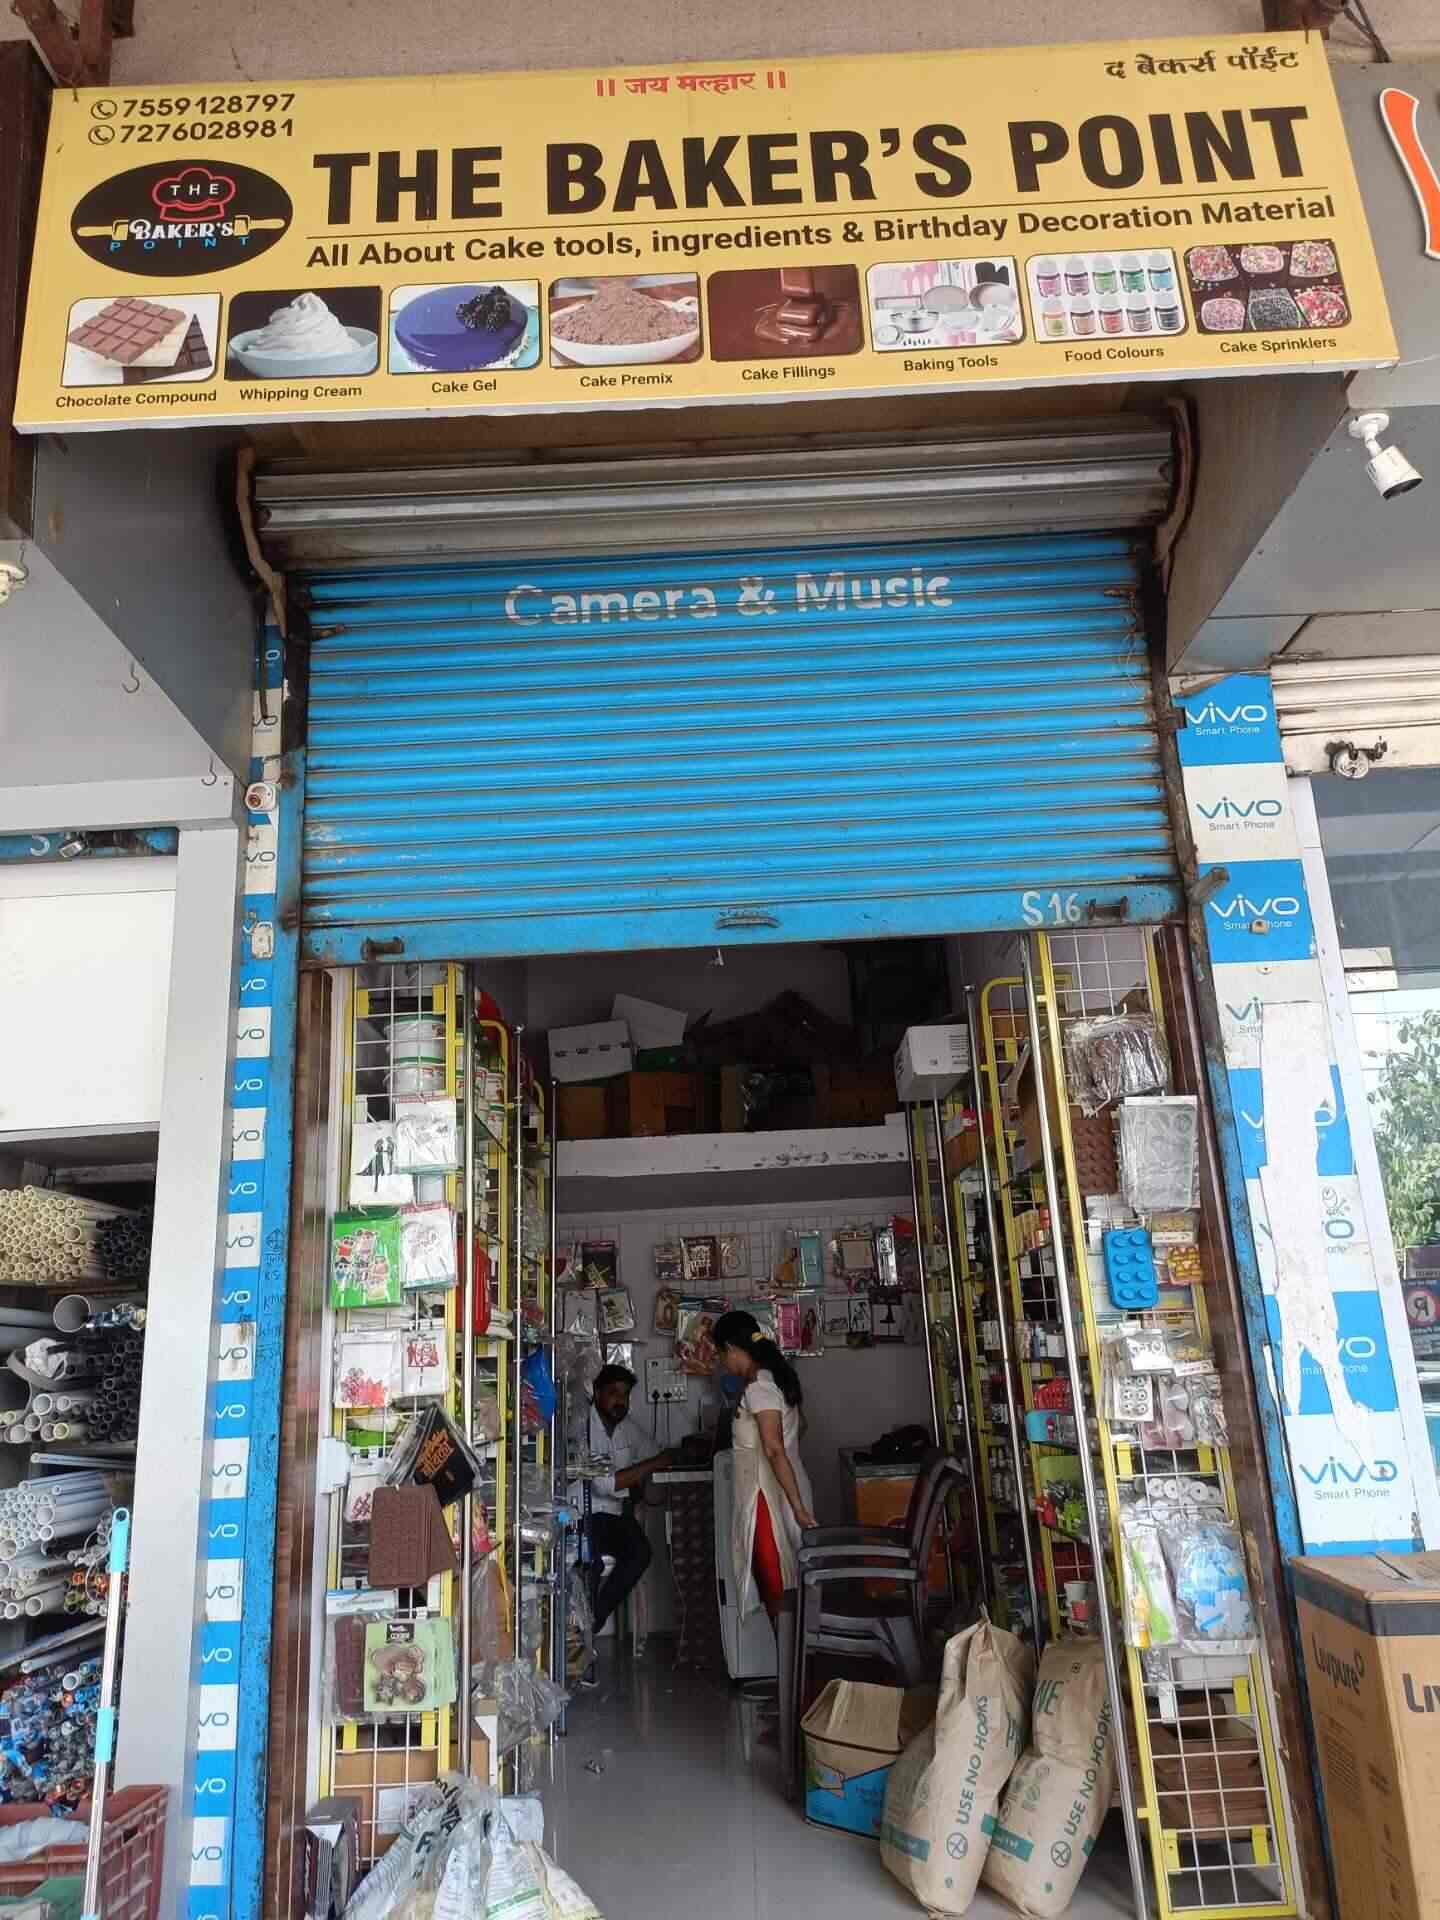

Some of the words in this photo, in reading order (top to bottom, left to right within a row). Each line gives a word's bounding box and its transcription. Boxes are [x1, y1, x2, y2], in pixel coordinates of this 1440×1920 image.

[1104, 61, 1127, 79] द
[1135, 50, 1217, 75] बेकर्स
[624, 77, 670, 94] जय
[676, 72, 756, 95] मल्हार
[123, 94, 295, 117] 7559128797
[120, 119, 294, 143] 7276028981
[313, 146, 503, 225] THE
[546, 123, 972, 215] BAKER'S
[1007, 106, 1309, 193] POINT
[170, 183, 219, 196] THE
[130, 218, 234, 241] BAKER'S
[306, 243, 348, 267] All
[359, 241, 455, 265] About
[465, 236, 545, 260] Cake
[554, 232, 642, 259] tools,
[652, 223, 832, 257] ingredients
[842, 221, 864, 243] &
[874, 214, 1008, 242] Birthday
[1018, 206, 1192, 234] Decoration
[1201, 195, 1335, 225] Material
[110, 236, 249, 251] POINT
[1065, 348, 1103, 363] Food
[1106, 345, 1165, 360] Colours
[1220, 341, 1258, 354] Cake
[1262, 336, 1337, 353] Sprinklers
[742, 367, 778, 381] Cake
[783, 364, 837, 380] Fillings
[903, 357, 955, 373] Baking
[958, 354, 999, 369] Tools
[431, 381, 469, 393] Cake
[473, 379, 498, 392] Gel
[580, 375, 616, 387] Cake
[621, 372, 673, 386] Premix
[56, 395, 131, 408] Chocolate
[136, 390, 217, 406] Compound
[240, 388, 309, 401] Whipping
[313, 386, 362, 398] Cream
[505, 584, 718, 625] Camera
[735, 577, 777, 616] &
[795, 568, 953, 612] Music
[1186, 701, 1268, 724] vivo
[1196, 727, 1225, 736] Smart
[1230, 725, 1260, 734] Phone
[1196, 796, 1282, 819] vivo
[1209, 822, 1240, 831] Smart
[1244, 820, 1275, 830] Phone
[1210, 894, 1299, 918] vivo
[1314, 1489, 1350, 1501] Smart
[1354, 1487, 1390, 1499] Phone
[956, 1788, 974, 1825] USE
[965, 1754, 982, 1786] NO
[974, 1695, 989, 1751] HOOKS
[1064, 1800, 1086, 1837] USE
[1080, 1768, 1097, 1799] NO
[1090, 1702, 1113, 1766] HOOKS
